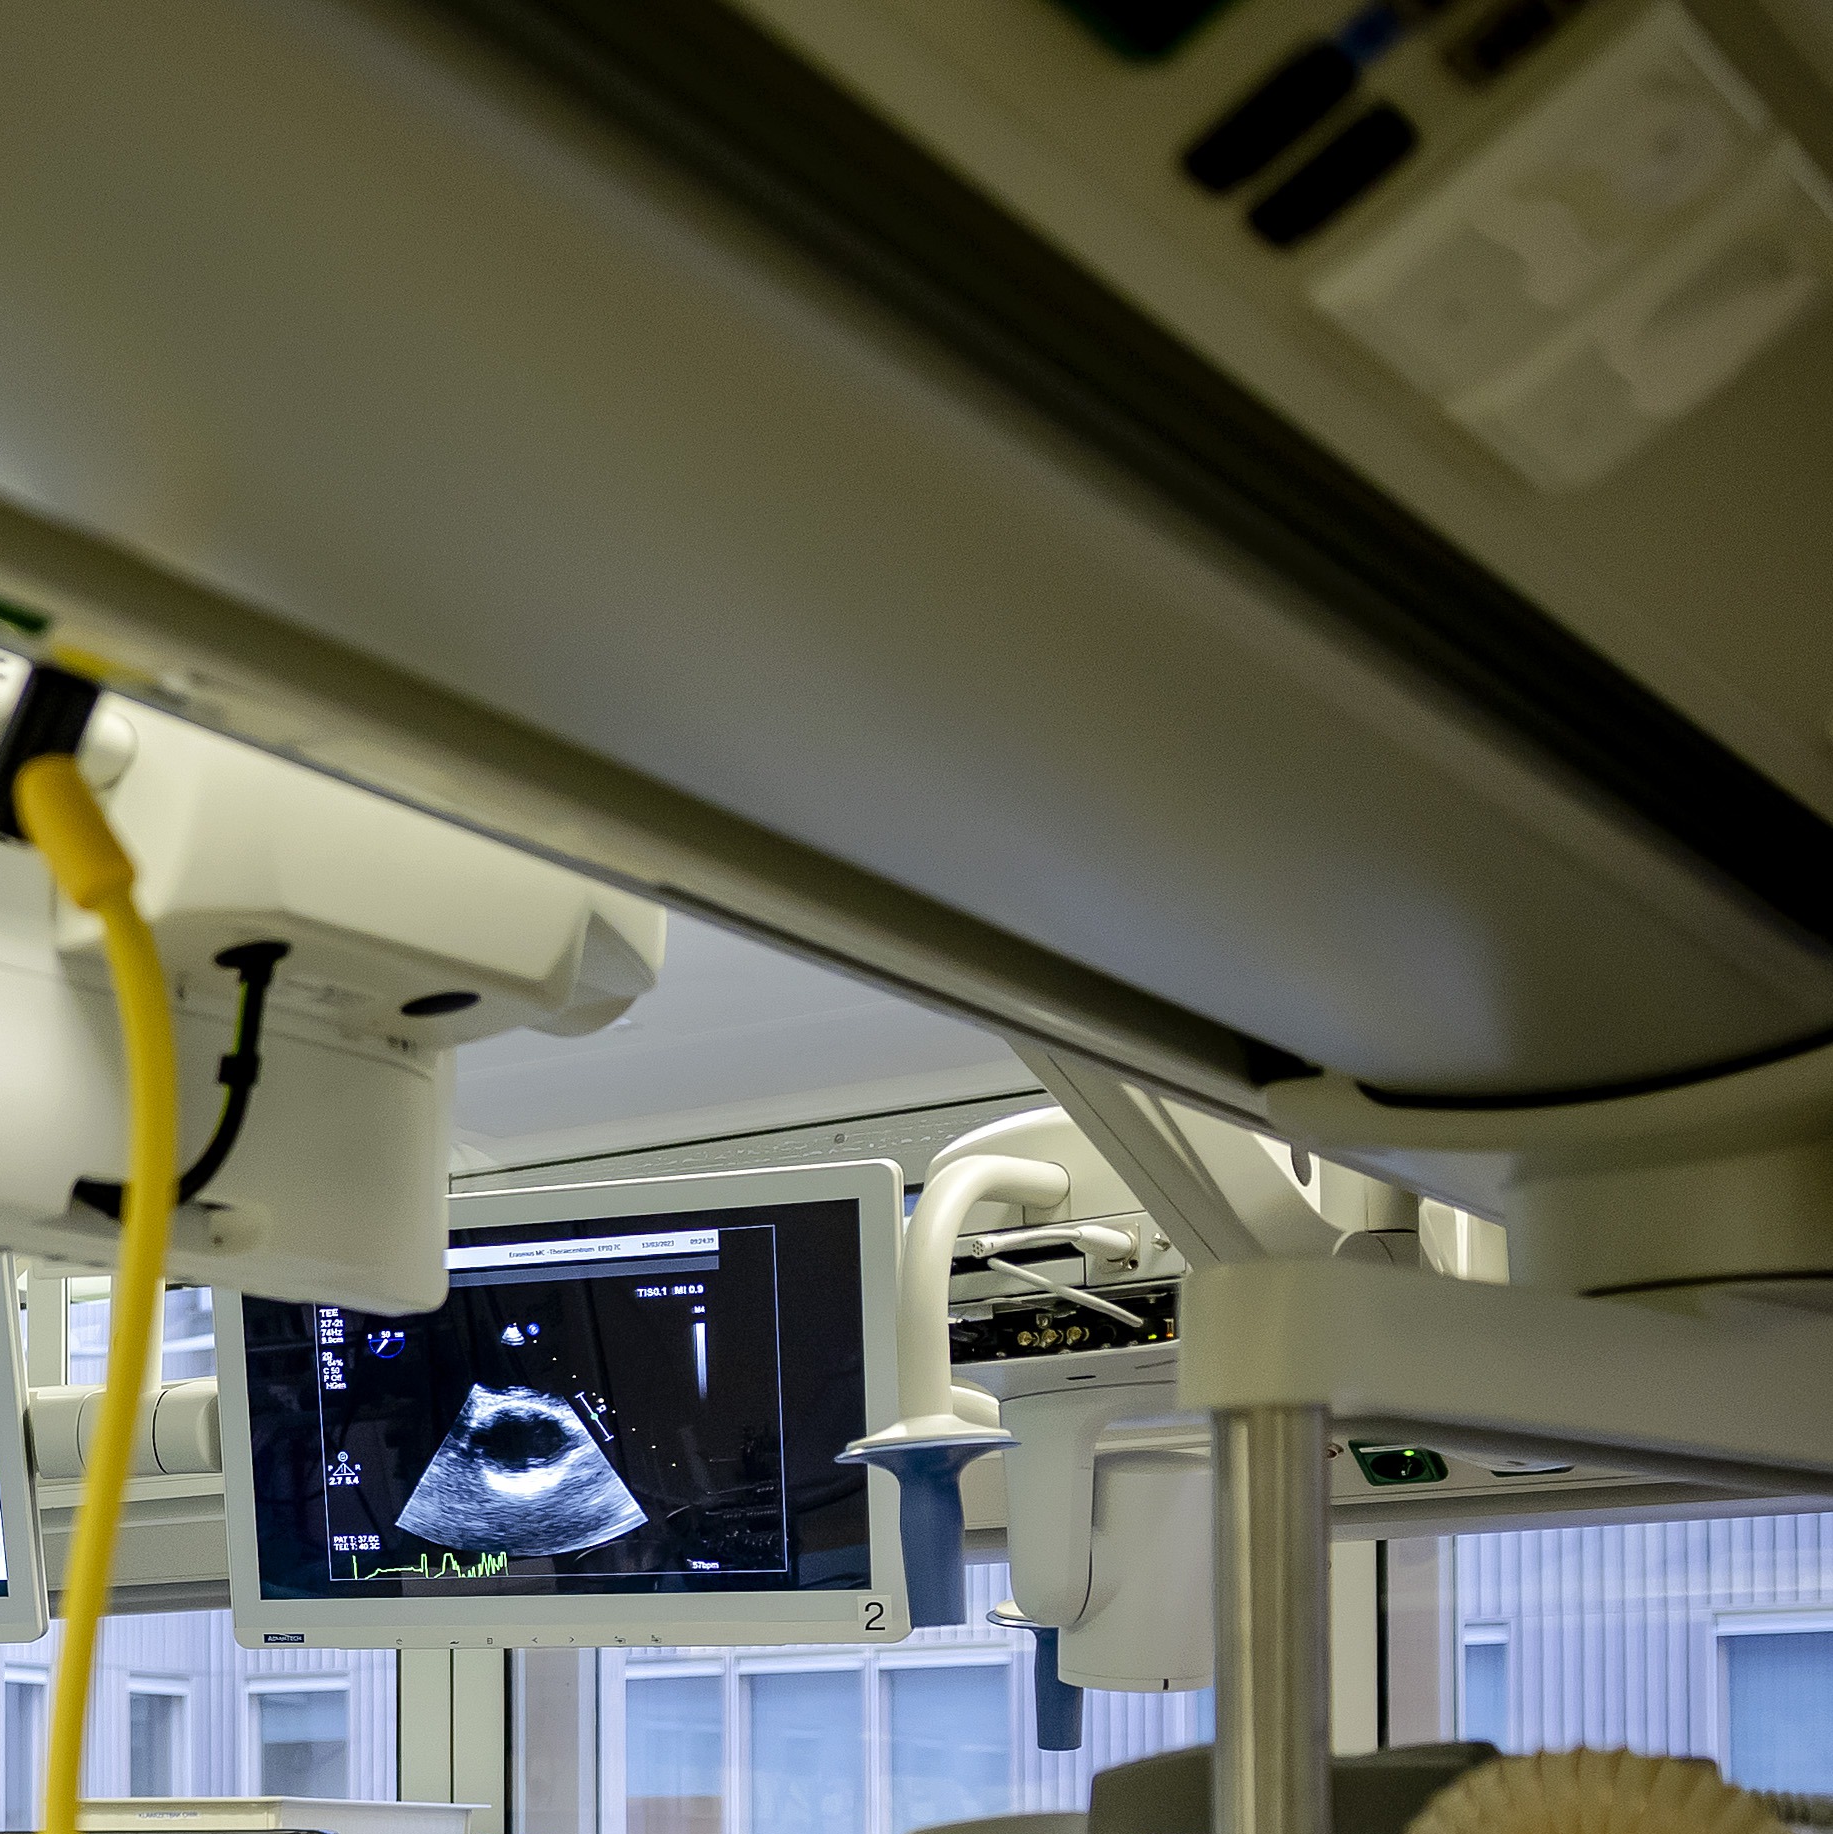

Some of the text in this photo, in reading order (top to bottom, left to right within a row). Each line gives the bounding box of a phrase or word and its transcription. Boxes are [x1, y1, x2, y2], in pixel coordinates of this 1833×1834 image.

[689, 1285, 704, 1294] 0.9
[319, 1308, 339, 1317] TEE
[320, 1319, 343, 1328] X7-2t
[321, 1328, 343, 1337] 74Hz
[329, 1477, 343, 1485] 2.7
[864, 1601, 886, 1631] 2
